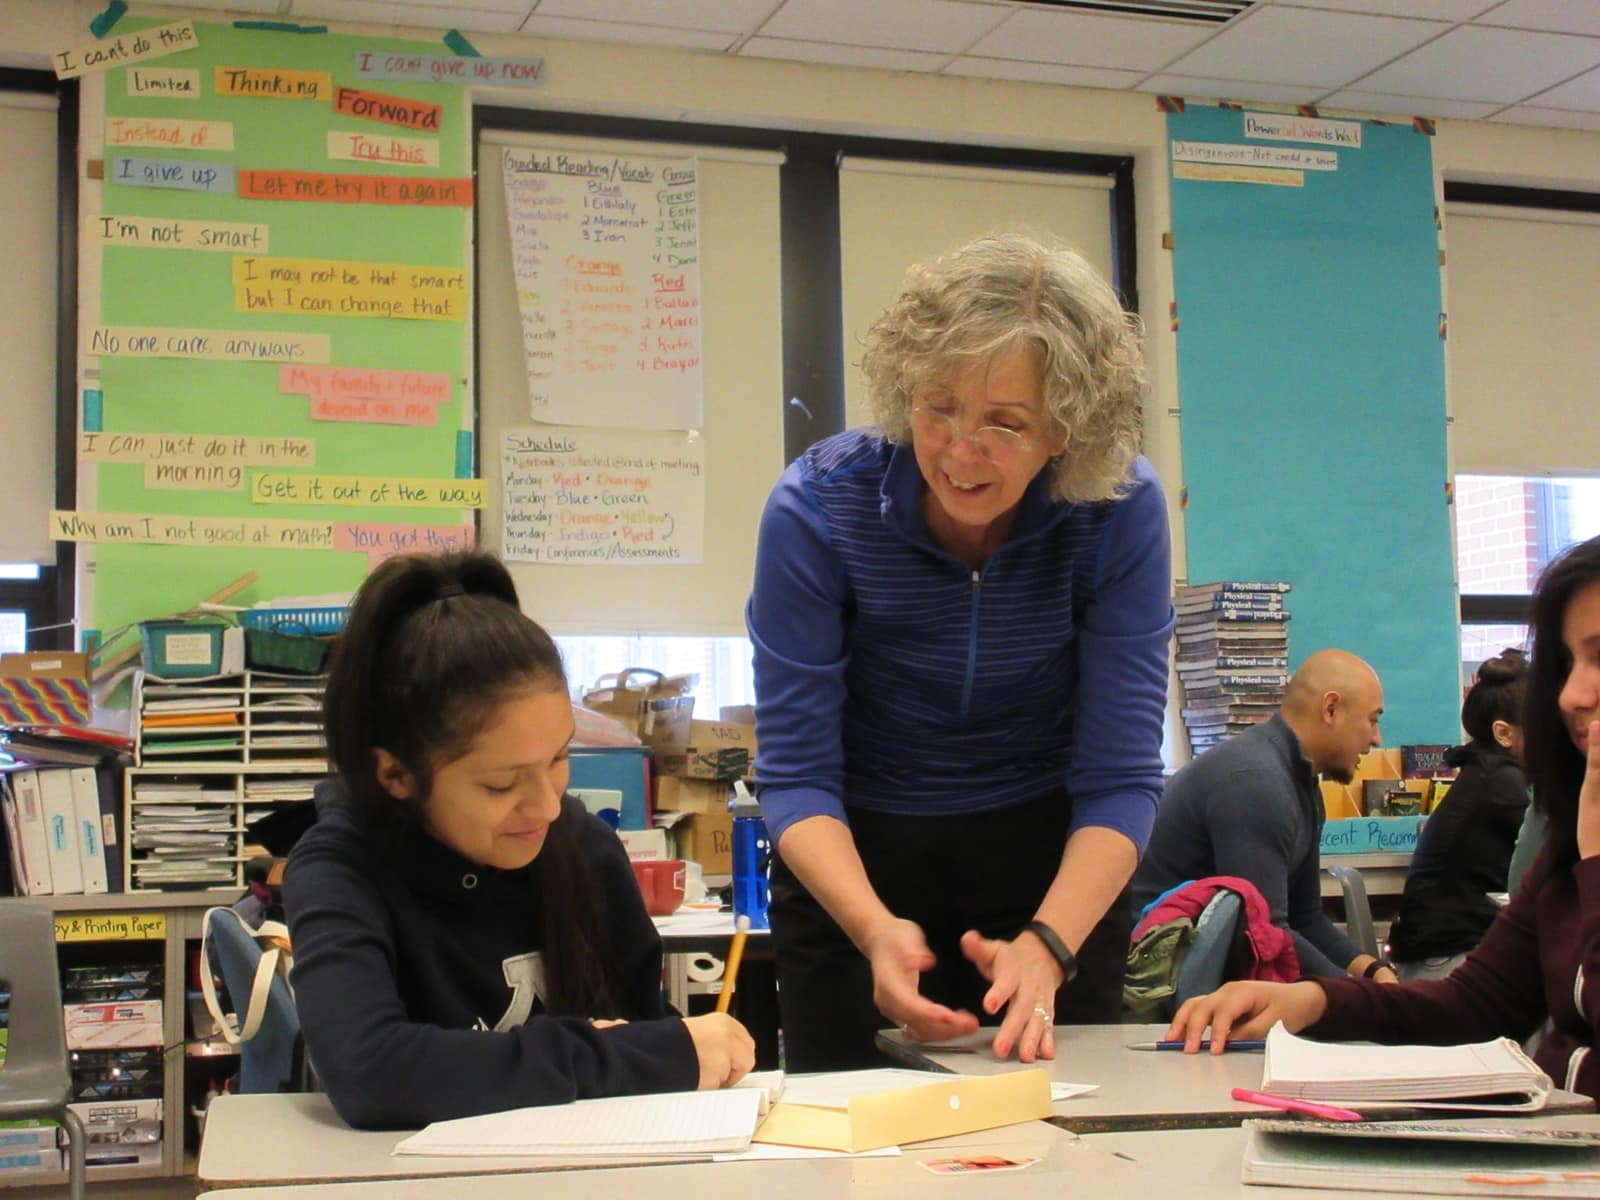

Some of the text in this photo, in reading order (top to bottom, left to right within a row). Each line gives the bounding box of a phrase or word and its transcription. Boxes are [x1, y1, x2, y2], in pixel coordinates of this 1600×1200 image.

[57, 51, 76, 72] I
[133, 36, 151, 54] do
[158, 27, 193, 48] this
[360, 53, 374, 72] I
[431, 58, 465, 82] give
[474, 64, 496, 80] up
[135, 71, 192, 92] Limited
[224, 70, 318, 98] Thinking
[337, 87, 439, 128] Forward
[112, 120, 209, 147] Instead of
[350, 136, 426, 163] Try this
[1253, 148, 1270, 160] Not
[119, 159, 217, 190] I give up
[249, 171, 457, 202] Let me try it again
[587, 180, 623, 196] Blue
[100, 217, 263, 247] I'm not smart
[243, 259, 465, 289] I may not be that smart
[651, 272, 686, 293] Red
[246, 288, 452, 318] but I can change that
[92, 329, 120, 353] No
[128, 337, 158, 352] one
[225, 339, 305, 361] anyways
[290, 370, 321, 394] My
[82, 434, 309, 459] I can just do it in the
[506, 433, 577, 453] Schedule
[156, 464, 241, 487] morning
[506, 472, 542, 487] Monday
[552, 474, 582, 488] Red
[257, 474, 482, 507] Get it out of the way
[506, 491, 649, 506] Tuesday Blue Green
[58, 516, 97, 539] Why
[105, 523, 134, 538] am
[141, 518, 155, 539] I
[164, 520, 197, 538] not
[203, 526, 245, 543] good
[252, 530, 270, 543] at
[347, 527, 383, 547] You
[622, 526, 655, 543] Red
[506, 543, 540, 561] Friday
[1224, 592, 1253, 600] Physical
[1232, 582, 1261, 591] Physical
[1222, 601, 1251, 610] Physical
[1227, 658, 1256, 667] Physical
[1231, 676, 1261, 686] Physical
[85, 918, 128, 938] Printing
[131, 917, 163, 938] Paper
